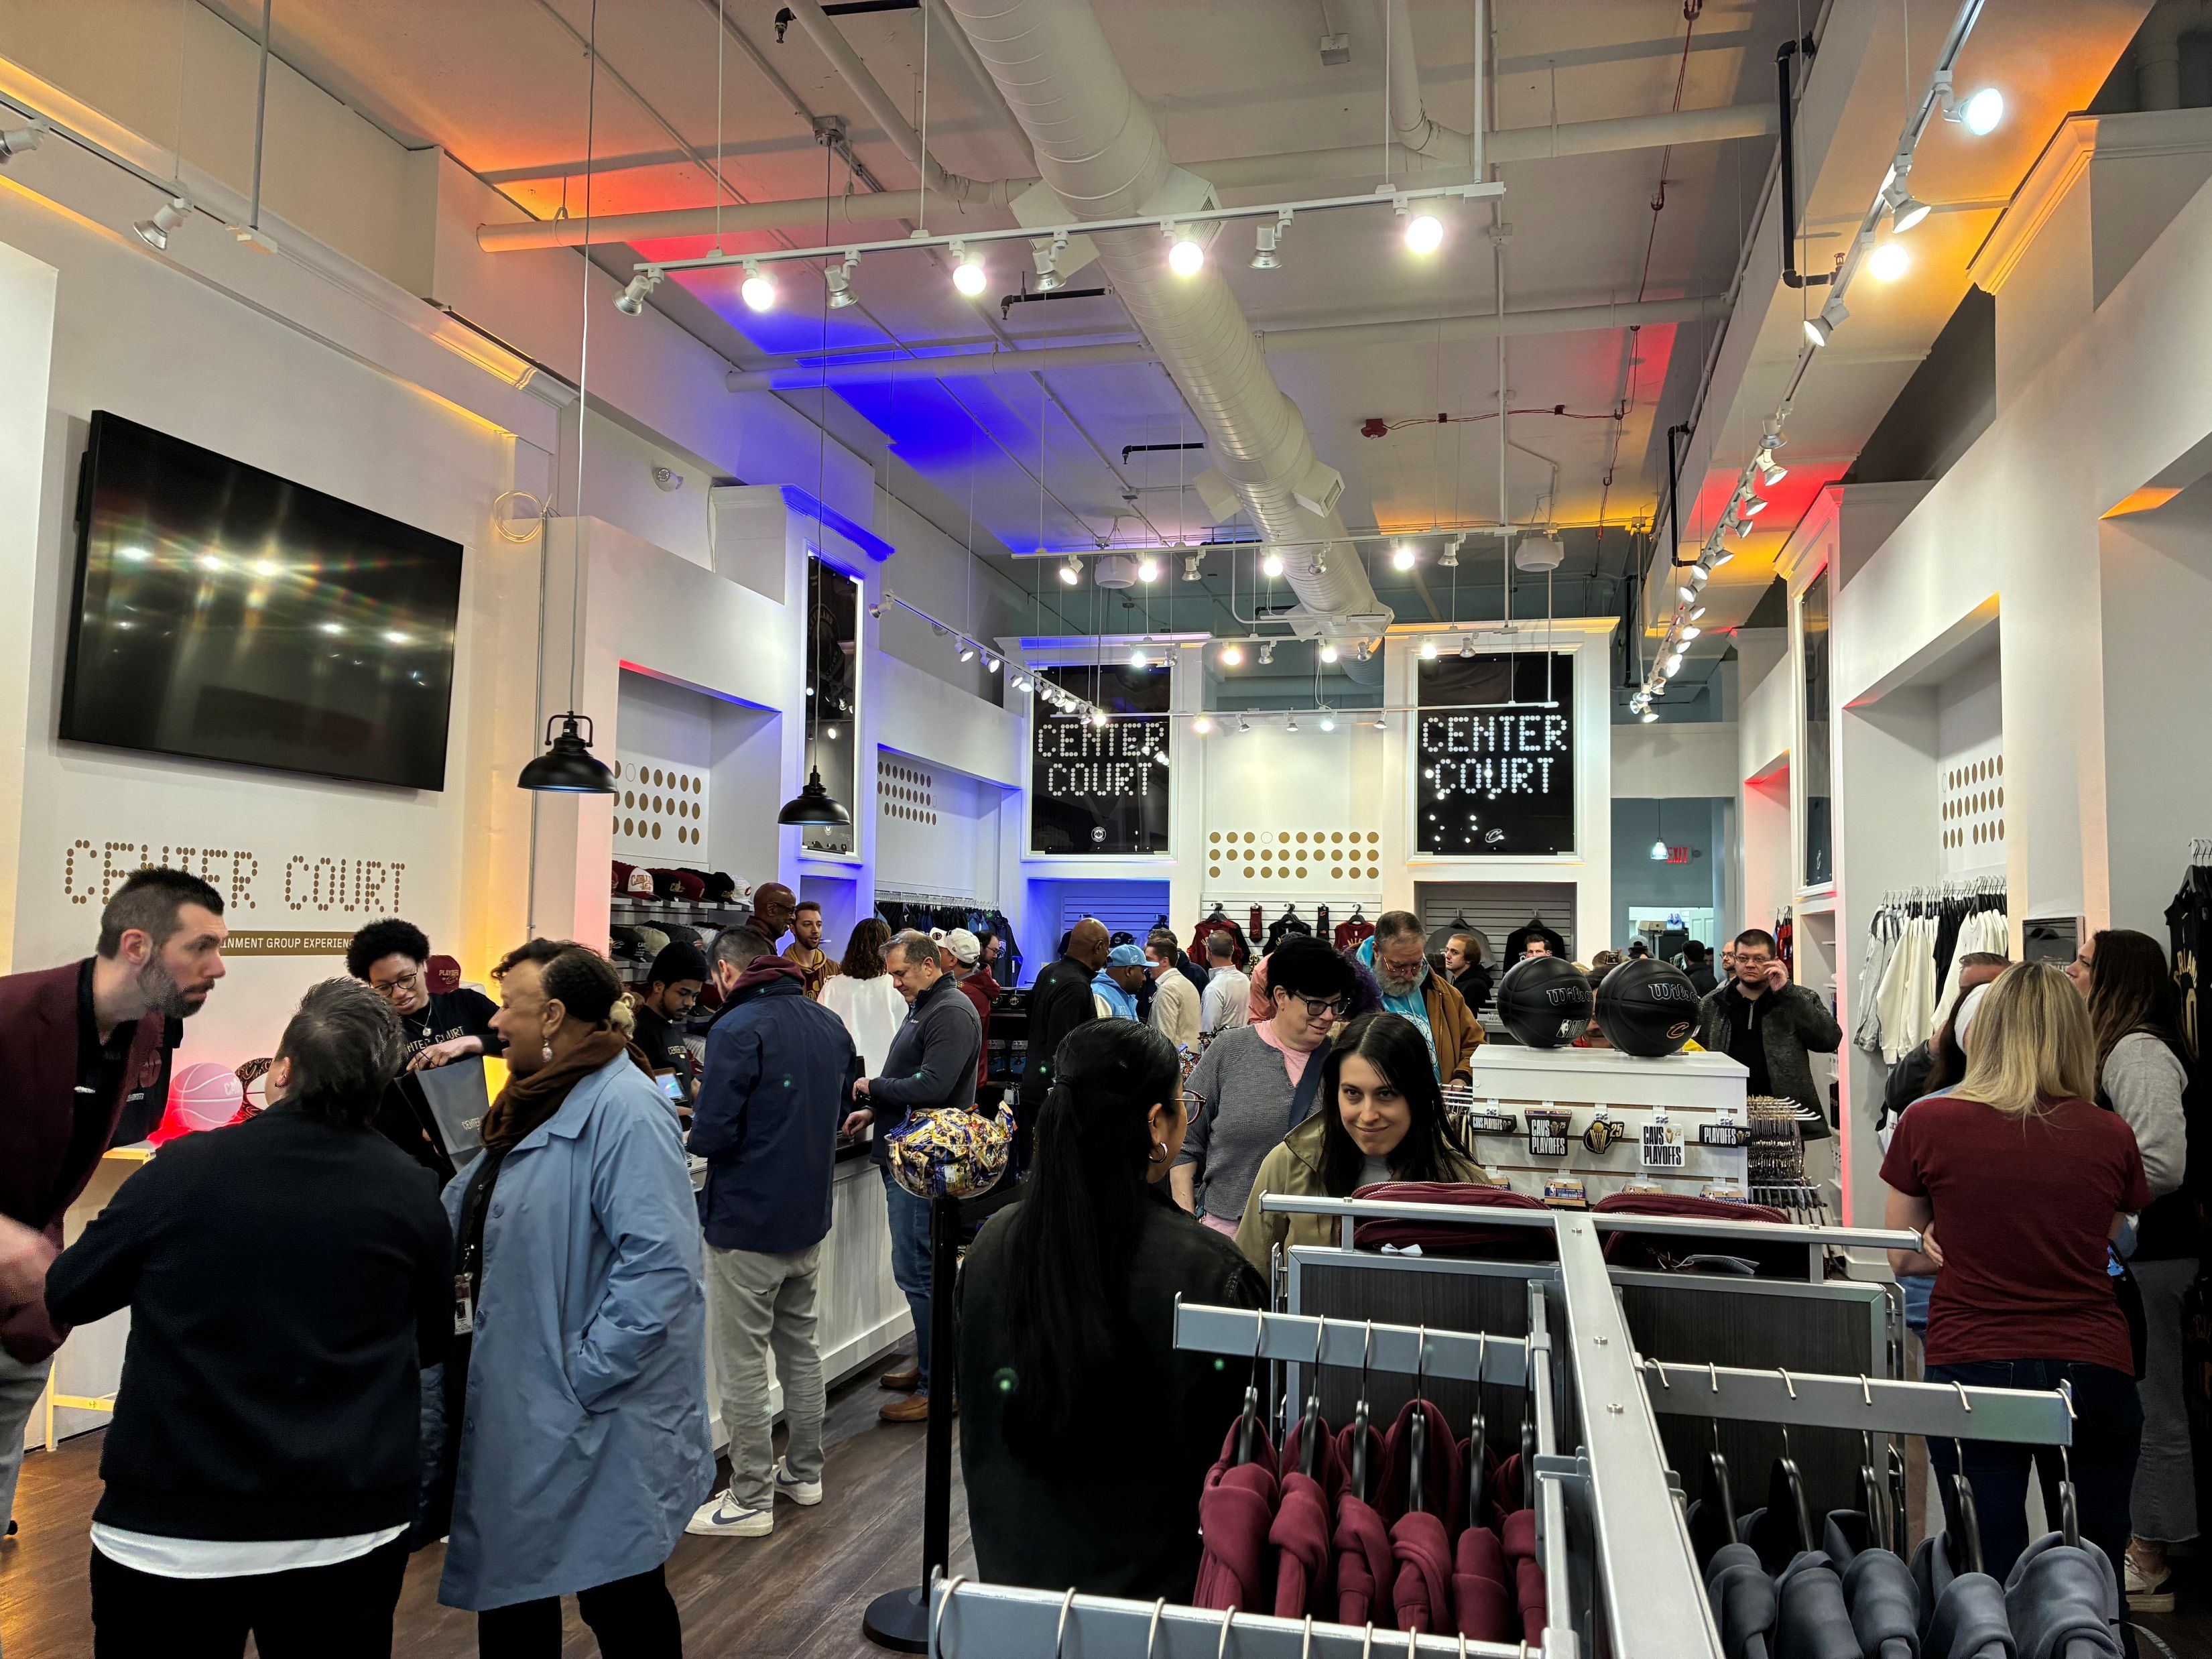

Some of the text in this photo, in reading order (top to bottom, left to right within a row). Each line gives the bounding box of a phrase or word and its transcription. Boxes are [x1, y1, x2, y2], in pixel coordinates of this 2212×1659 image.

[1038, 723, 1164, 757] CENTER
[1422, 715, 1566, 752] CENTER
[1048, 762, 1152, 796] COURT
[1435, 757, 1554, 794] COURT
[1666, 847, 1688, 864] EXIT
[285, 855, 405, 913] COURT
[221, 938, 354, 948] INMENT GROUP EXPERIENC
[1546, 986, 1593, 1006] Wilso
[1473, 1117, 1484, 1129] CAVS
[1484, 1117, 1503, 1131] PLAYOFFS
[1532, 1119, 1550, 1138] CAVS
[1609, 1123, 1623, 1138] 25
[1644, 1126, 1664, 1145] CAVS
[1704, 1127, 1737, 1145] PLAYOFFS
[1532, 1137, 1565, 1155] PLAYOFFS
[1644, 1146, 1682, 1166] PLAYOFFS
